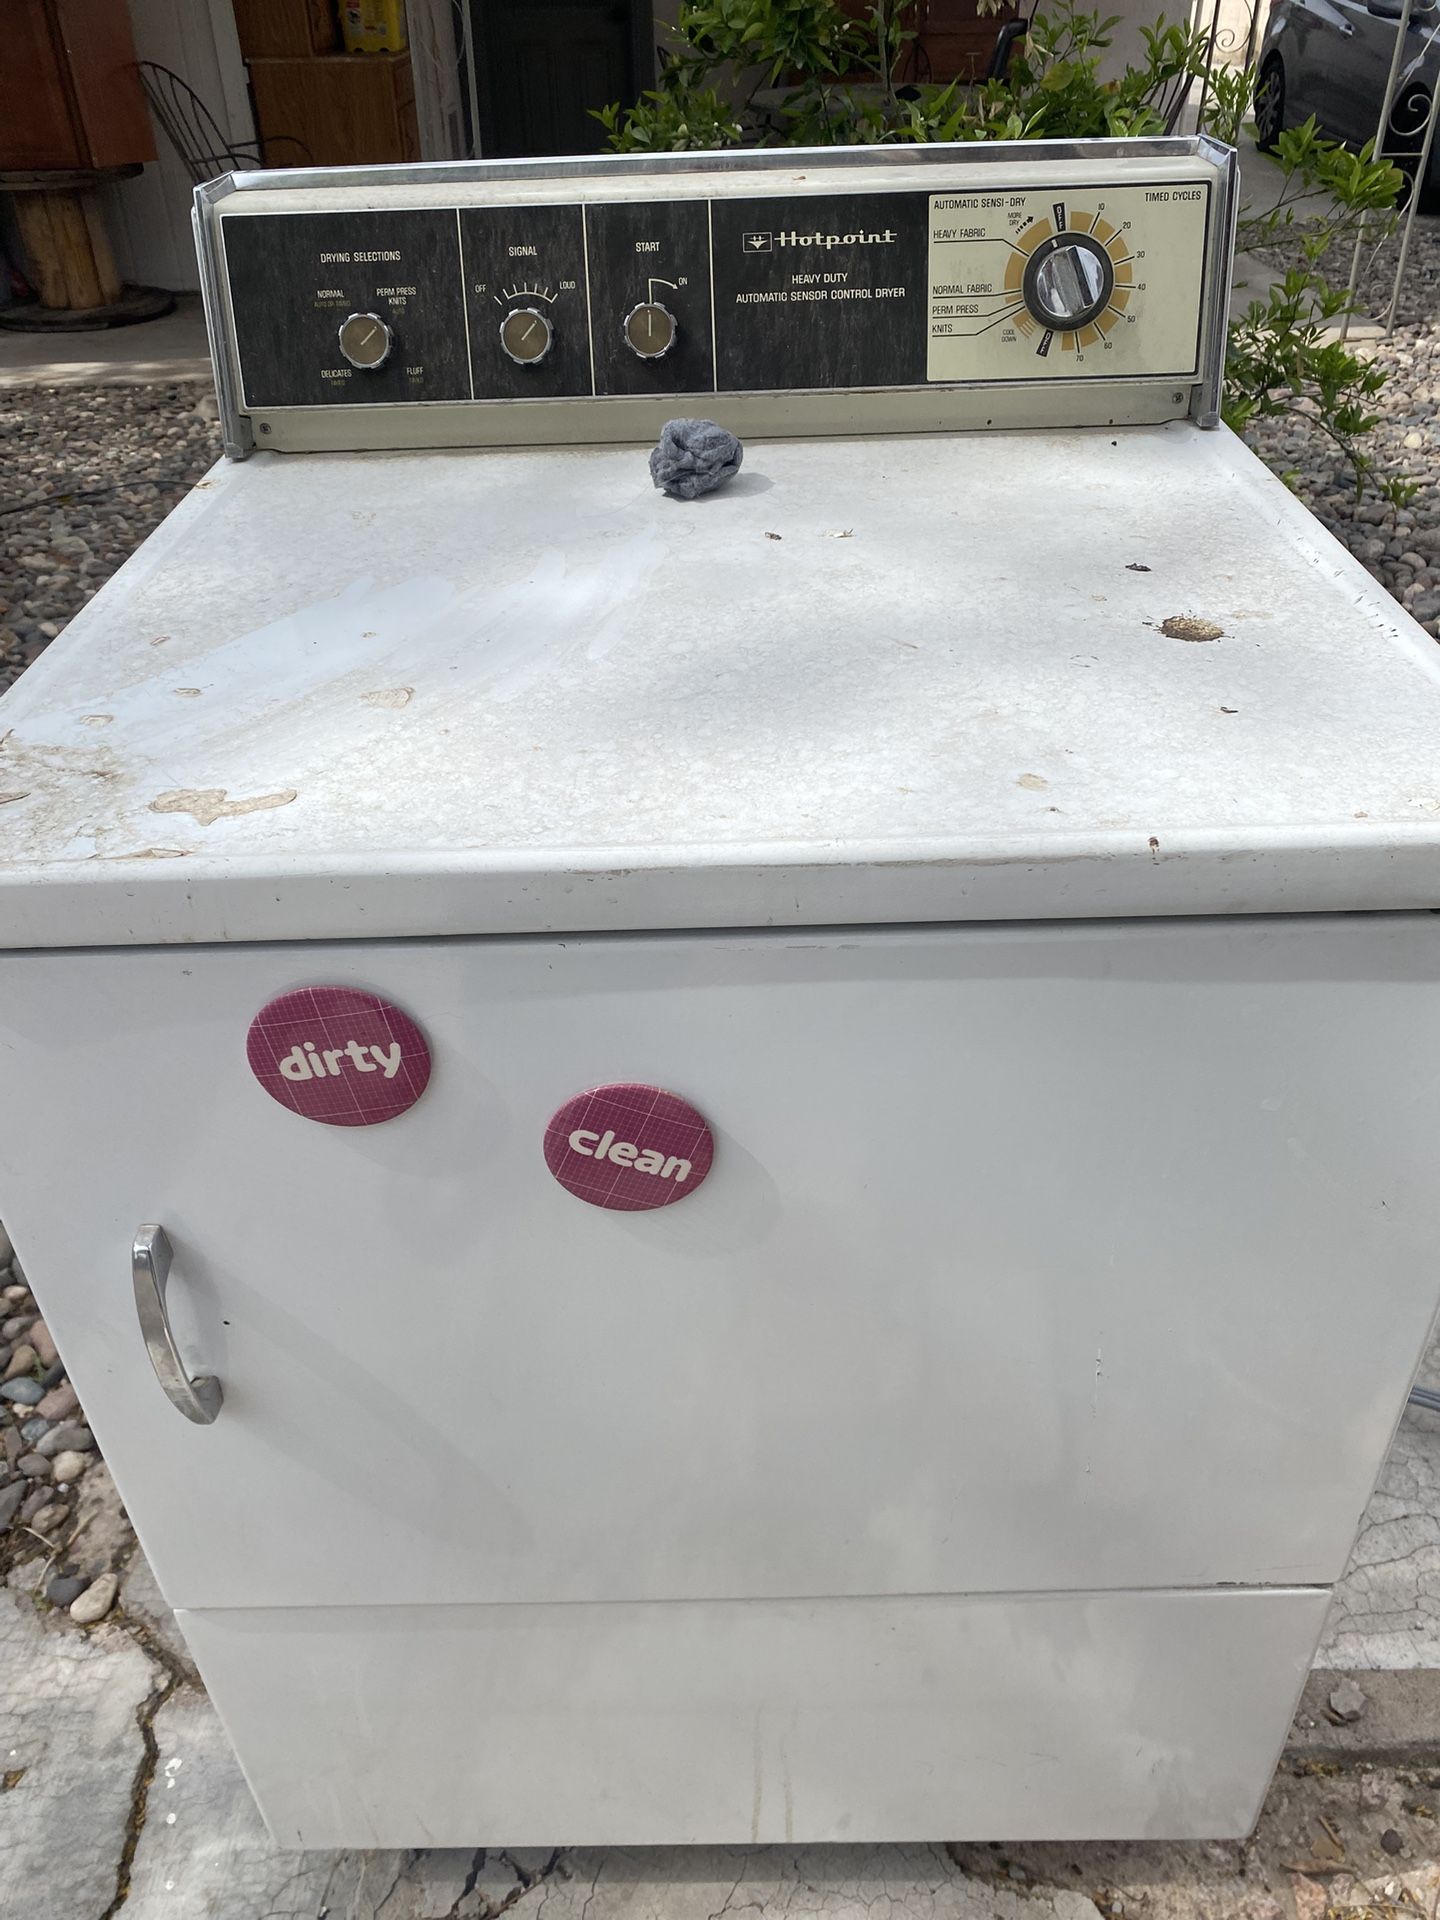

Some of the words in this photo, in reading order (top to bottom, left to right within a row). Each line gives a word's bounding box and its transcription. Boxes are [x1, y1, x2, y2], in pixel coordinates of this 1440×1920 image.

[1145, 191, 1170, 202] TIMED
[1172, 190, 1202, 200] CYCLES
[934, 198, 979, 210] AUTOMATIC
[1098, 203, 1105, 212] 10
[1056, 206, 1064, 230] OFF
[1122, 221, 1132, 230] 20
[933, 229, 957, 239] HEAVY
[960, 227, 986, 238] FABRIC
[774, 229, 897, 249] Hotpoint
[508, 246, 538, 257] SIGNAL
[635, 241, 660, 253] START
[320, 252, 351, 264] DRYING
[353, 250, 401, 262] SELECTIONS
[1136, 250, 1146, 259] 30
[678, 277, 688, 287] ON
[792, 274, 822, 285] HEAVY
[823, 272, 848, 284] DUTY
[475, 284, 486, 294] OFF
[560, 281, 576, 290] LOUD
[932, 285, 964, 296] NORMAL
[966, 283, 993, 294] FABRIC
[1137, 283, 1147, 292] 40
[317, 289, 345, 299] NORMAL
[376, 287, 396, 297] PERM
[396, 286, 417, 296] PRESS
[736, 292, 788, 304] AUTOMATIC
[790, 290, 828, 302] SENSOR
[831, 289, 874, 300] CONTROL
[875, 287, 906, 299] DRYER
[388, 296, 407, 306] KNITS
[932, 306, 955, 315] PERM
[956, 304, 979, 314] PRESS
[1127, 315, 1136, 324] 50
[931, 324, 953, 334] KNITS
[1040, 332, 1051, 353] OFF
[1103, 342, 1112, 351] 60
[1075, 354, 1084, 363] 70
[321, 369, 352, 378] DELICATES
[406, 367, 424, 375] FLUFF
[279, 1041, 402, 1081] dirty
[568, 1129, 692, 1182] clean
